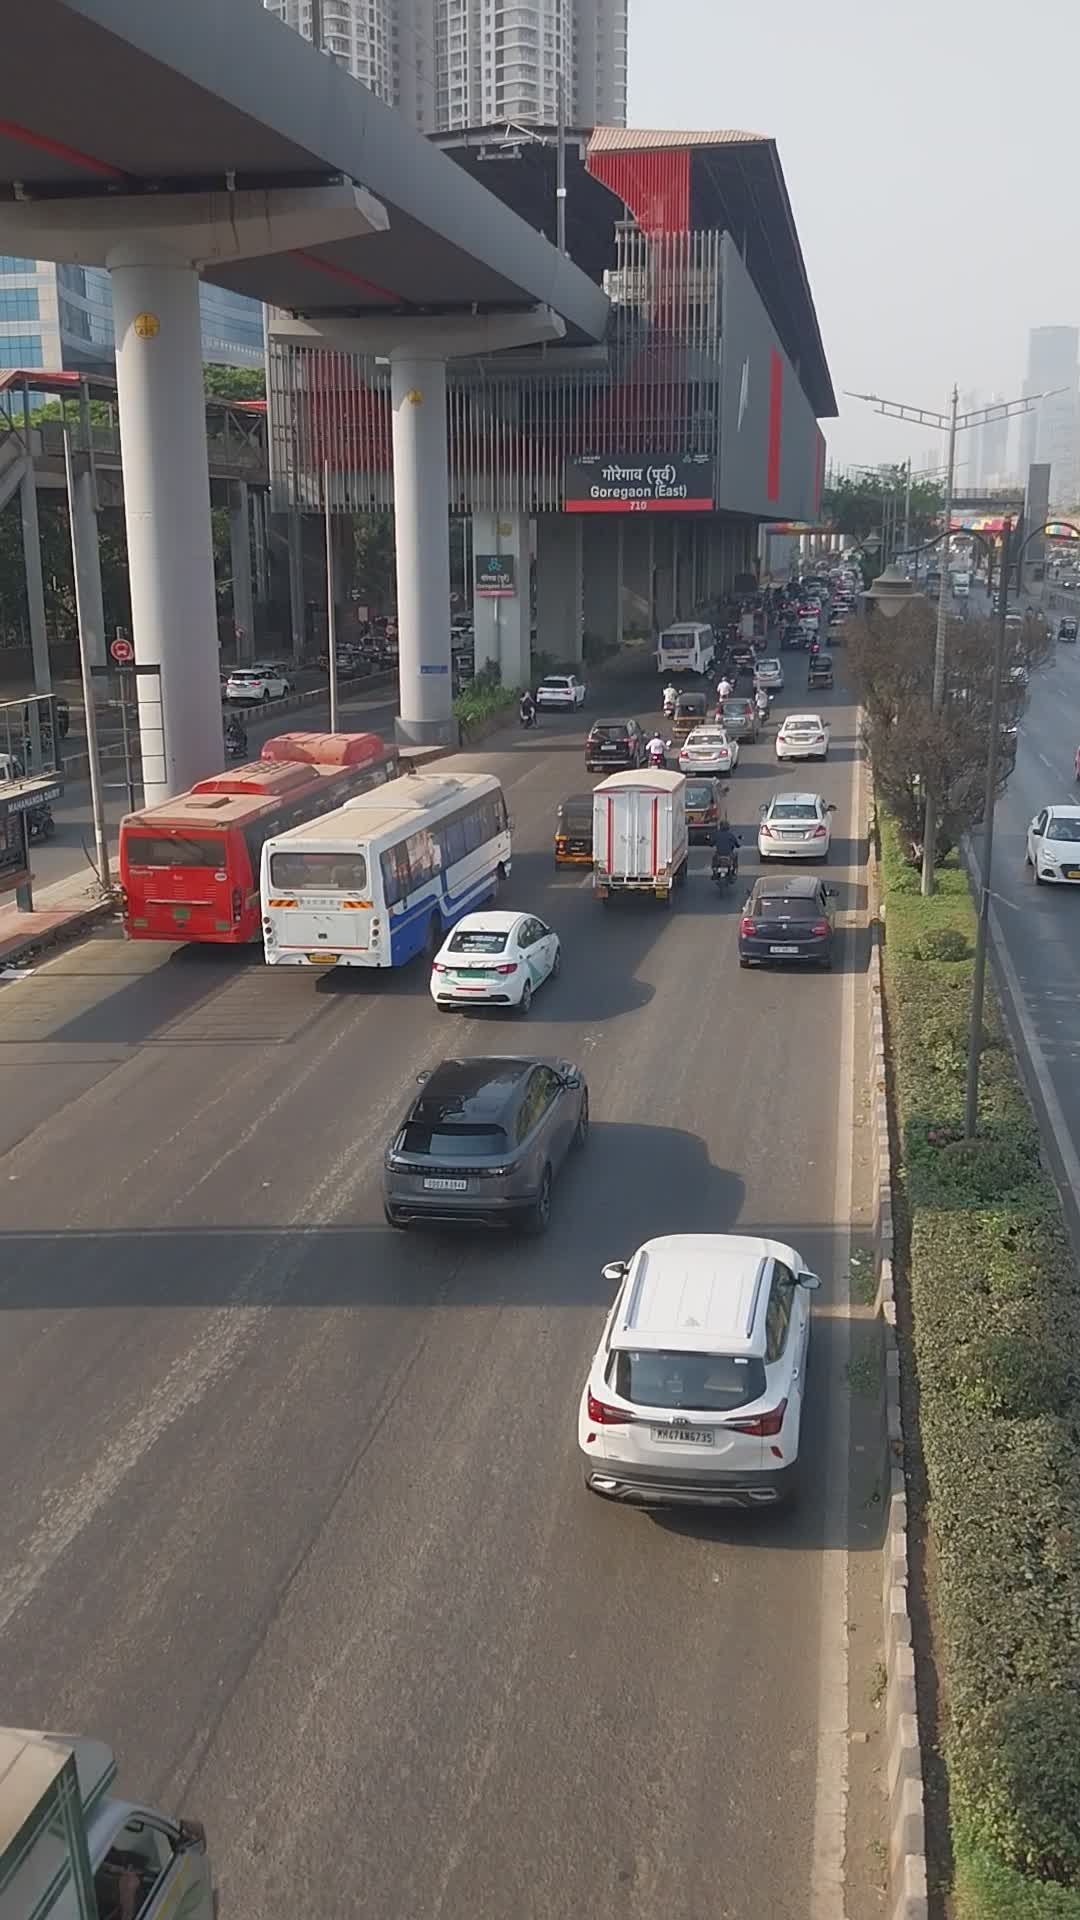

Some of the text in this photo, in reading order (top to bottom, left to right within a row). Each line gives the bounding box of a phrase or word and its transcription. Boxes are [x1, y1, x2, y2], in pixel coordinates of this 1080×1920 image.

[646, 464, 676, 485] (पूर्व)
[590, 484, 687, 500] Goregaon (East)
[630, 501, 647, 511] 710
